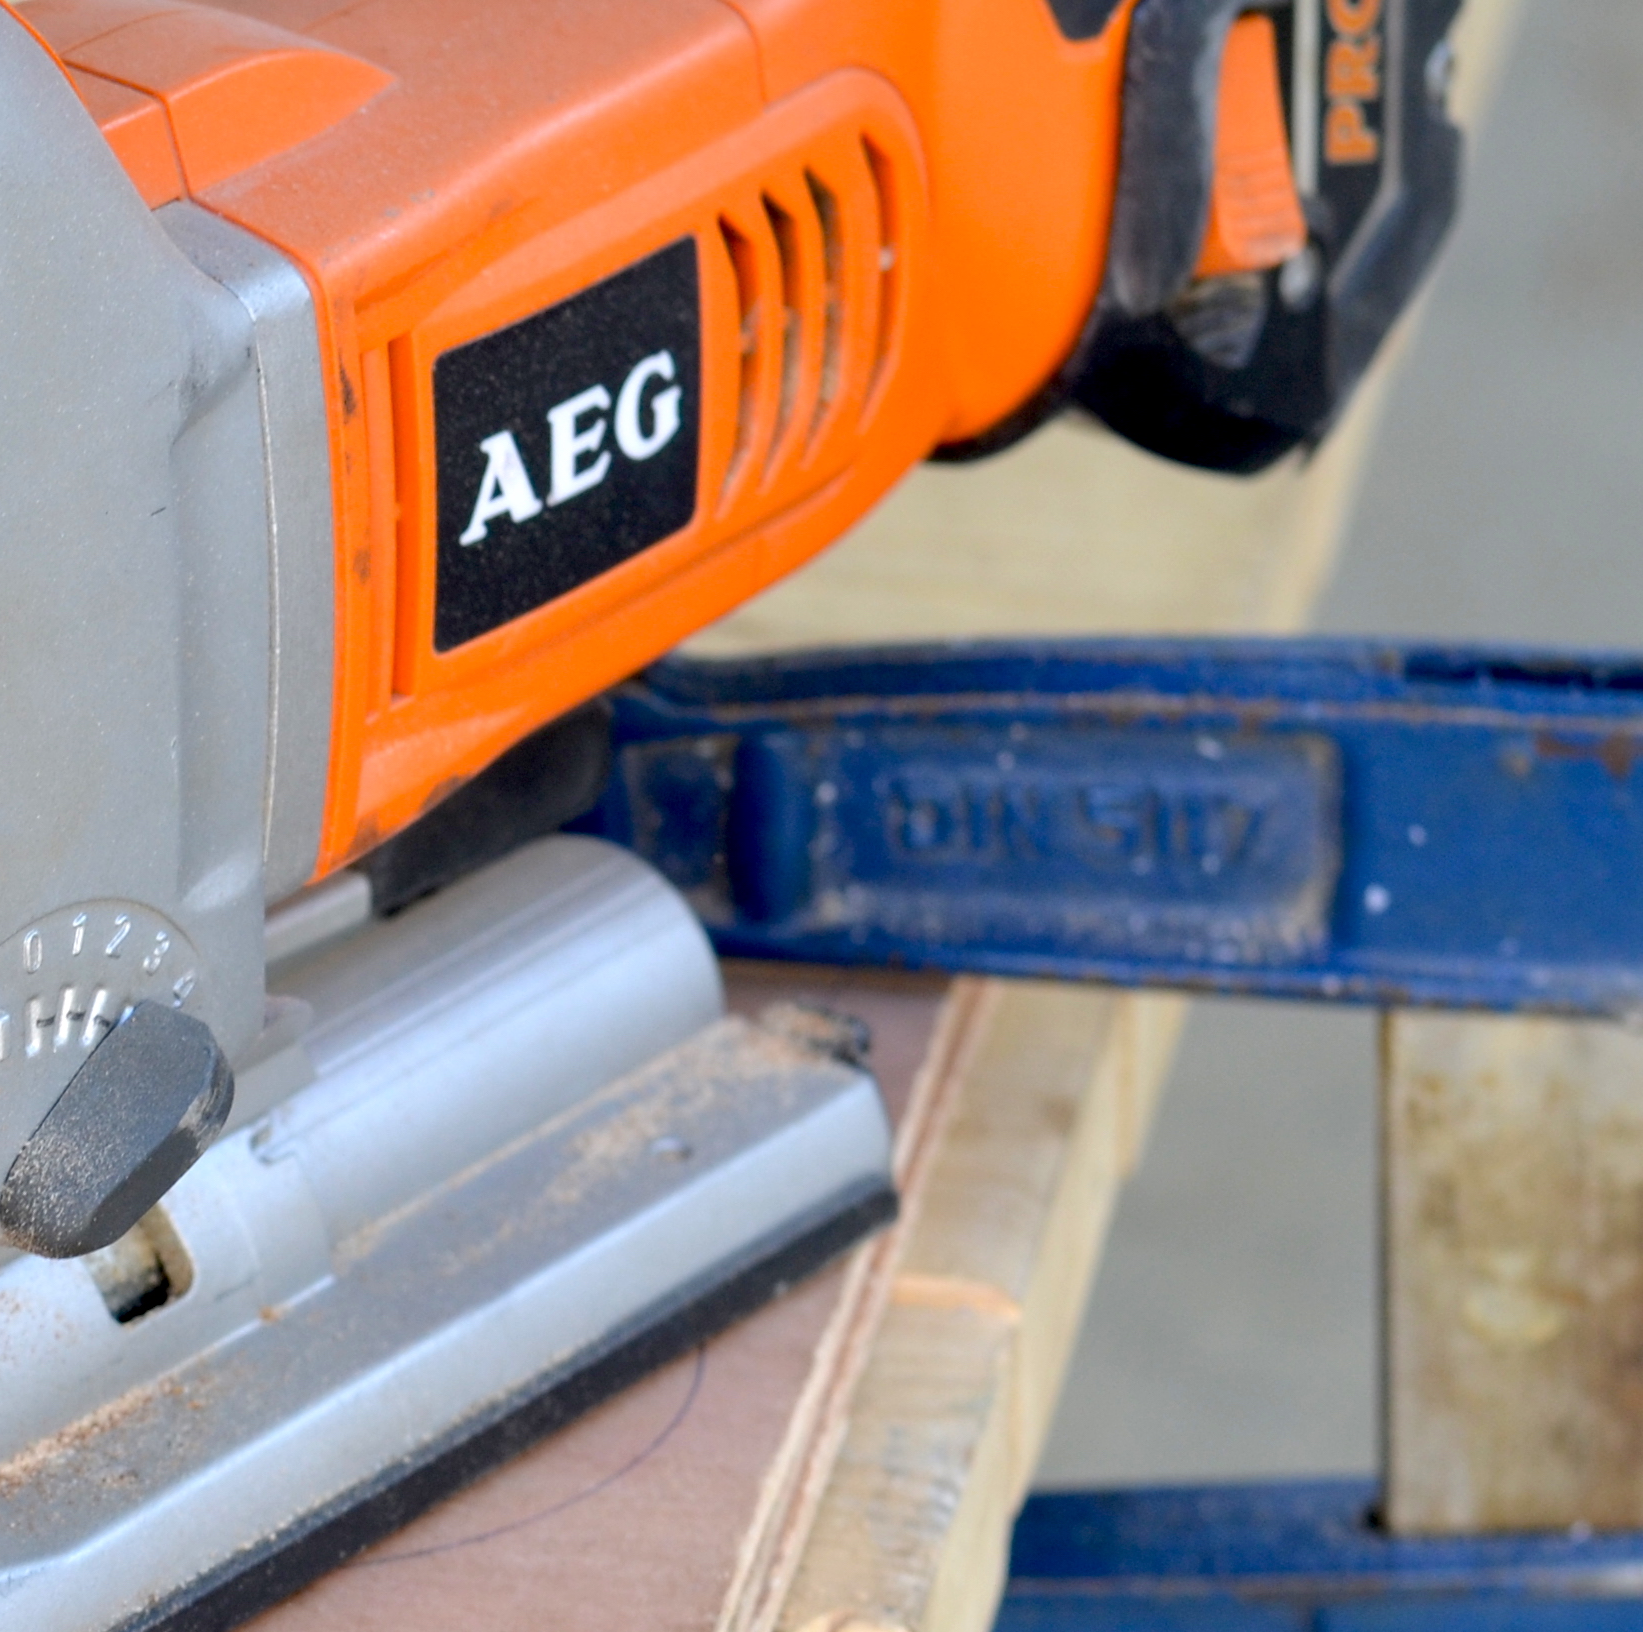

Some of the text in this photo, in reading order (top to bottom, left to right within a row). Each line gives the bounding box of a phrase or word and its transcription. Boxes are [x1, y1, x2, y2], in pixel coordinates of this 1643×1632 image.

[459, 350, 682, 547] AEG
[23, 929, 42, 974] 0
[72, 912, 88, 956] 1
[105, 914, 131, 958] 2
[143, 931, 170, 975] 3
